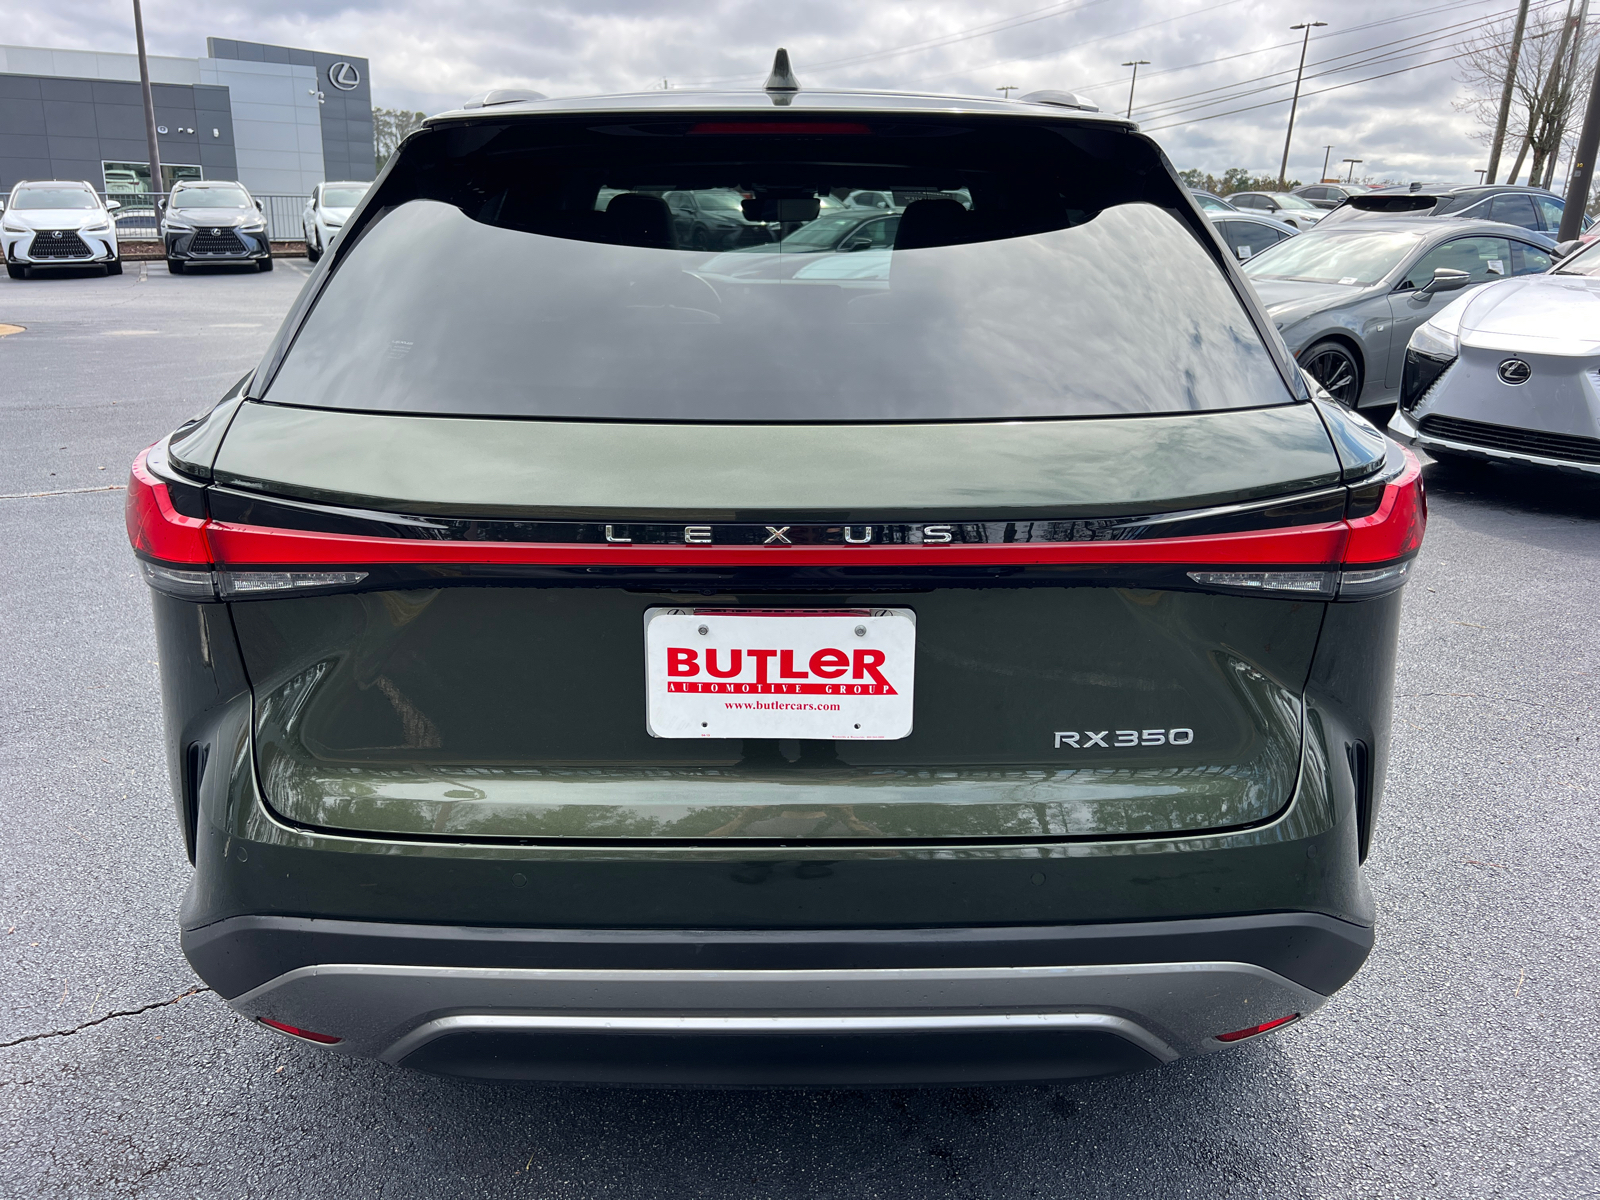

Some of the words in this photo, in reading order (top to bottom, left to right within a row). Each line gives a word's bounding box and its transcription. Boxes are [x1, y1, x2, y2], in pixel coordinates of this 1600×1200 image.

[605, 525, 952, 544] LEXUS
[668, 682, 802, 693] AUTOMOTIVE
[825, 684, 889, 694] GROUP
[724, 701, 841, 711] www.butlercars.com
